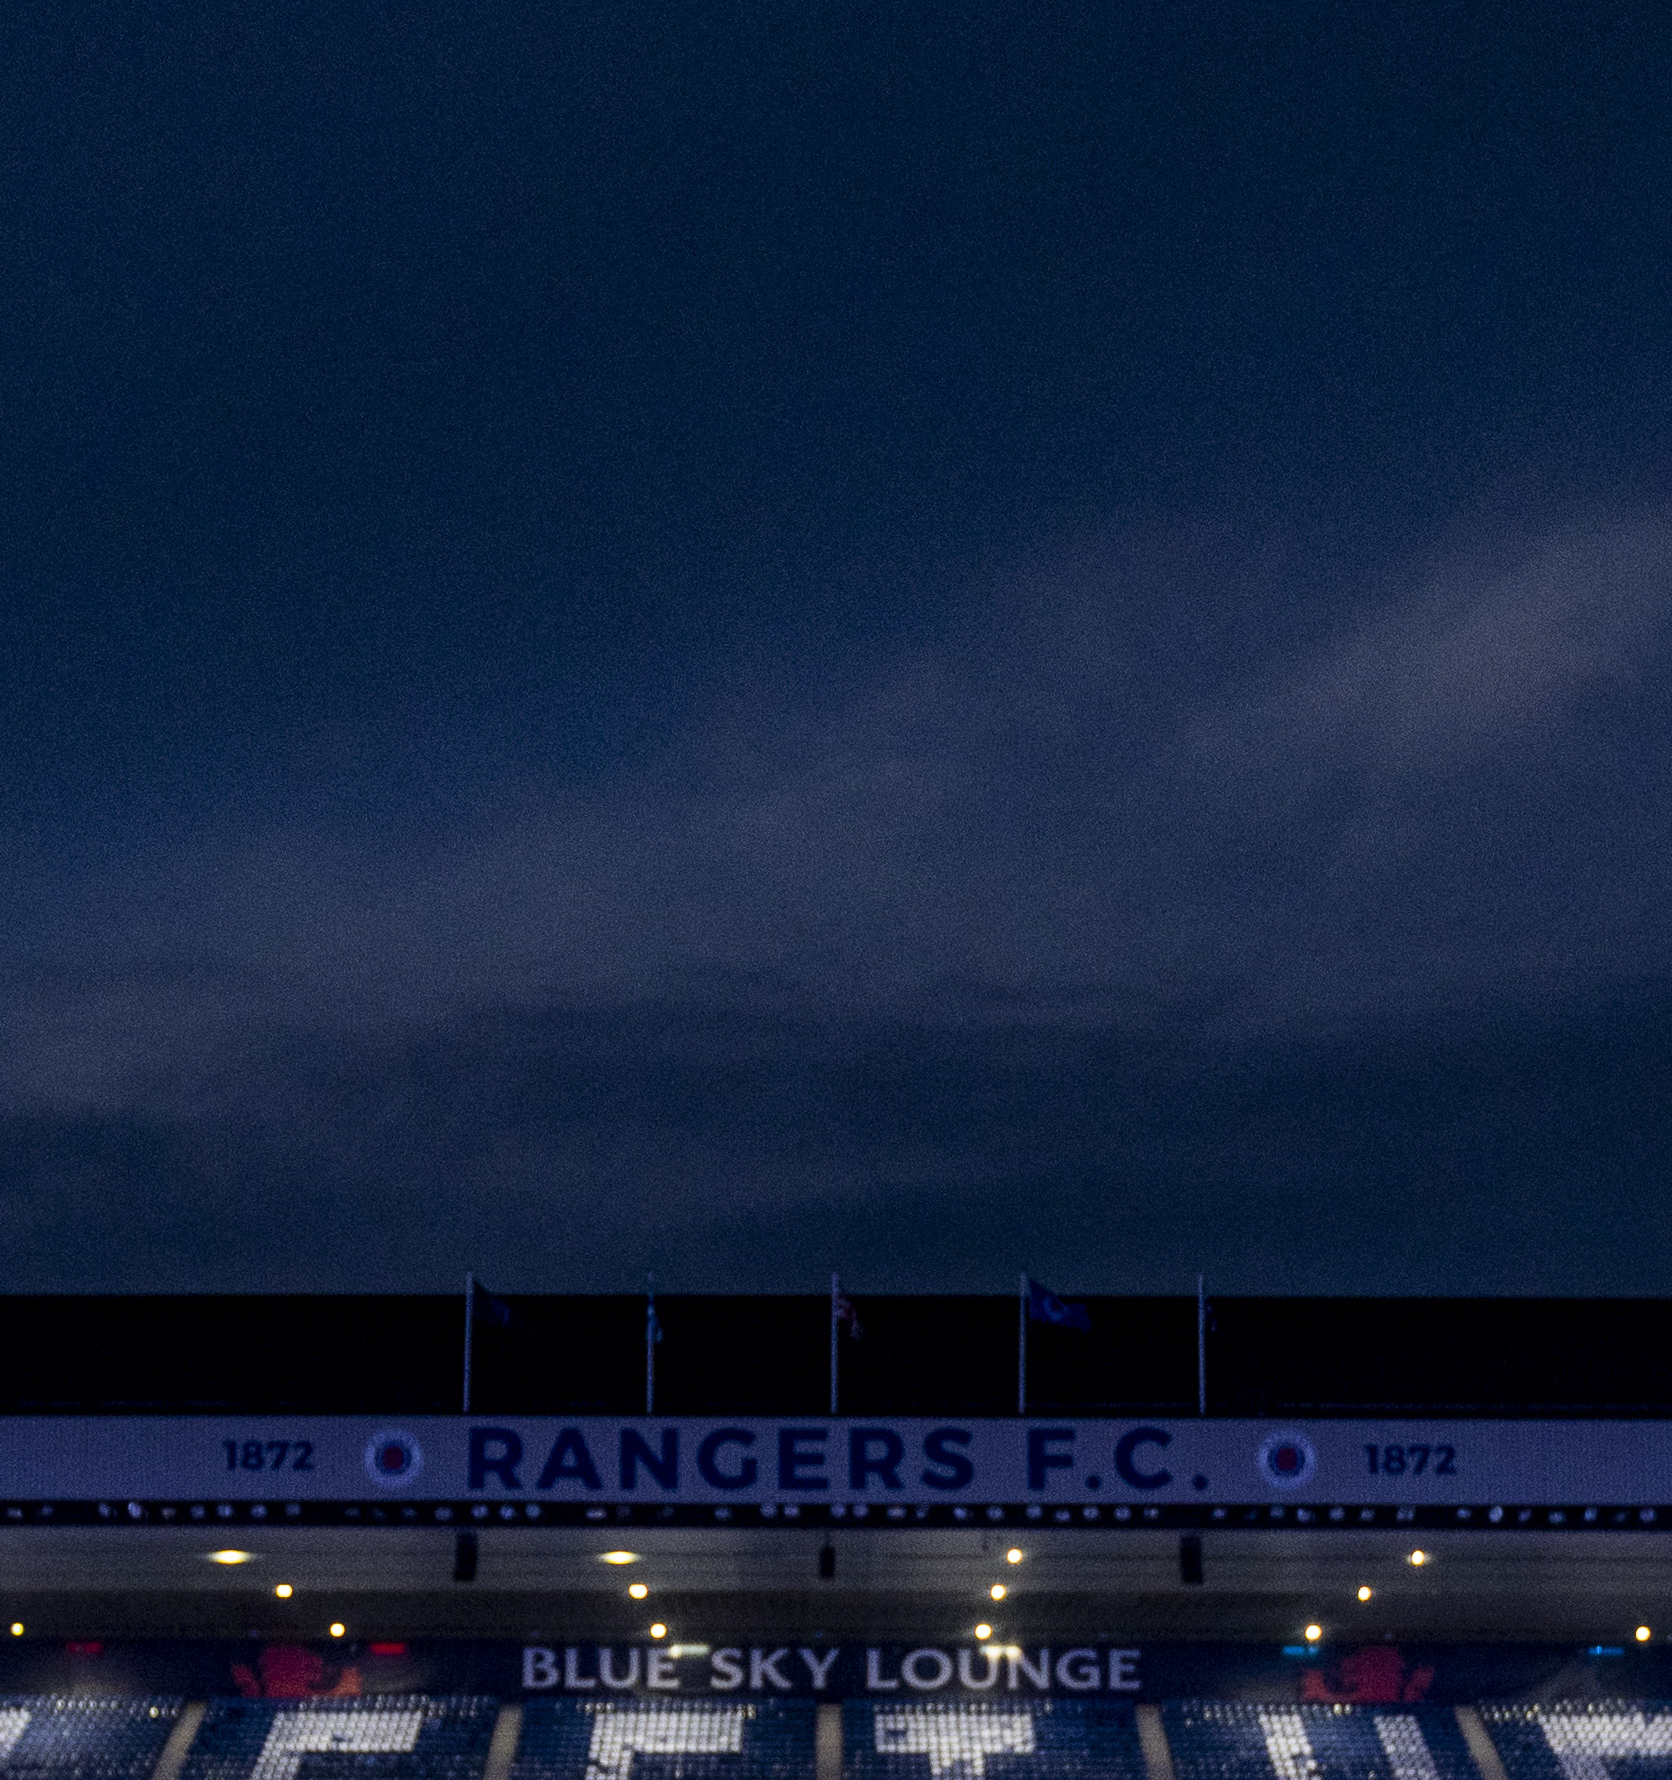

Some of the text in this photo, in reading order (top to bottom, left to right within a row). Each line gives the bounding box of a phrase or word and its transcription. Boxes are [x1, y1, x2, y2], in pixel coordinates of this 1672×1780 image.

[222, 1439, 315, 1472] 1872
[467, 1427, 1211, 1491] RANGERS F.C.
[1365, 1443, 1457, 1476] 1872
[522, 1646, 1143, 1692] BLUE SKY LOUNGE
